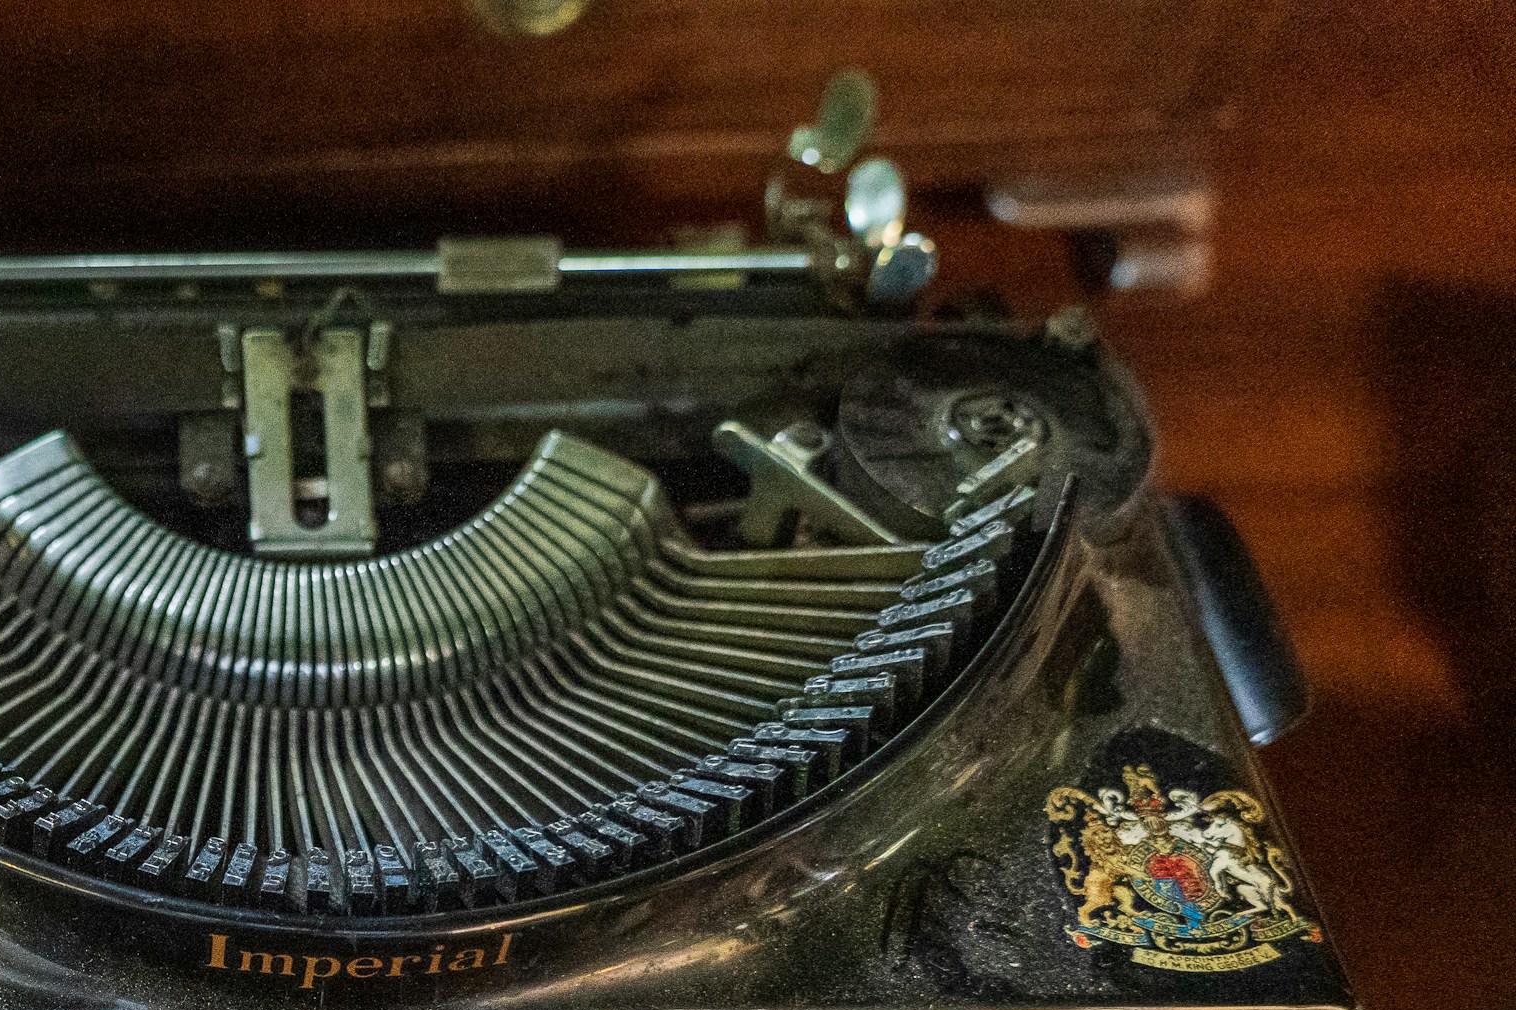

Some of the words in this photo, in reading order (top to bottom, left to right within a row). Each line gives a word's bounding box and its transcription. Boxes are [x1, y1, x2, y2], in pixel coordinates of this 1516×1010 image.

[204, 933, 513, 989] Imperial
[1186, 961, 1214, 972] KING
[1217, 955, 1262, 971] GEORGE
